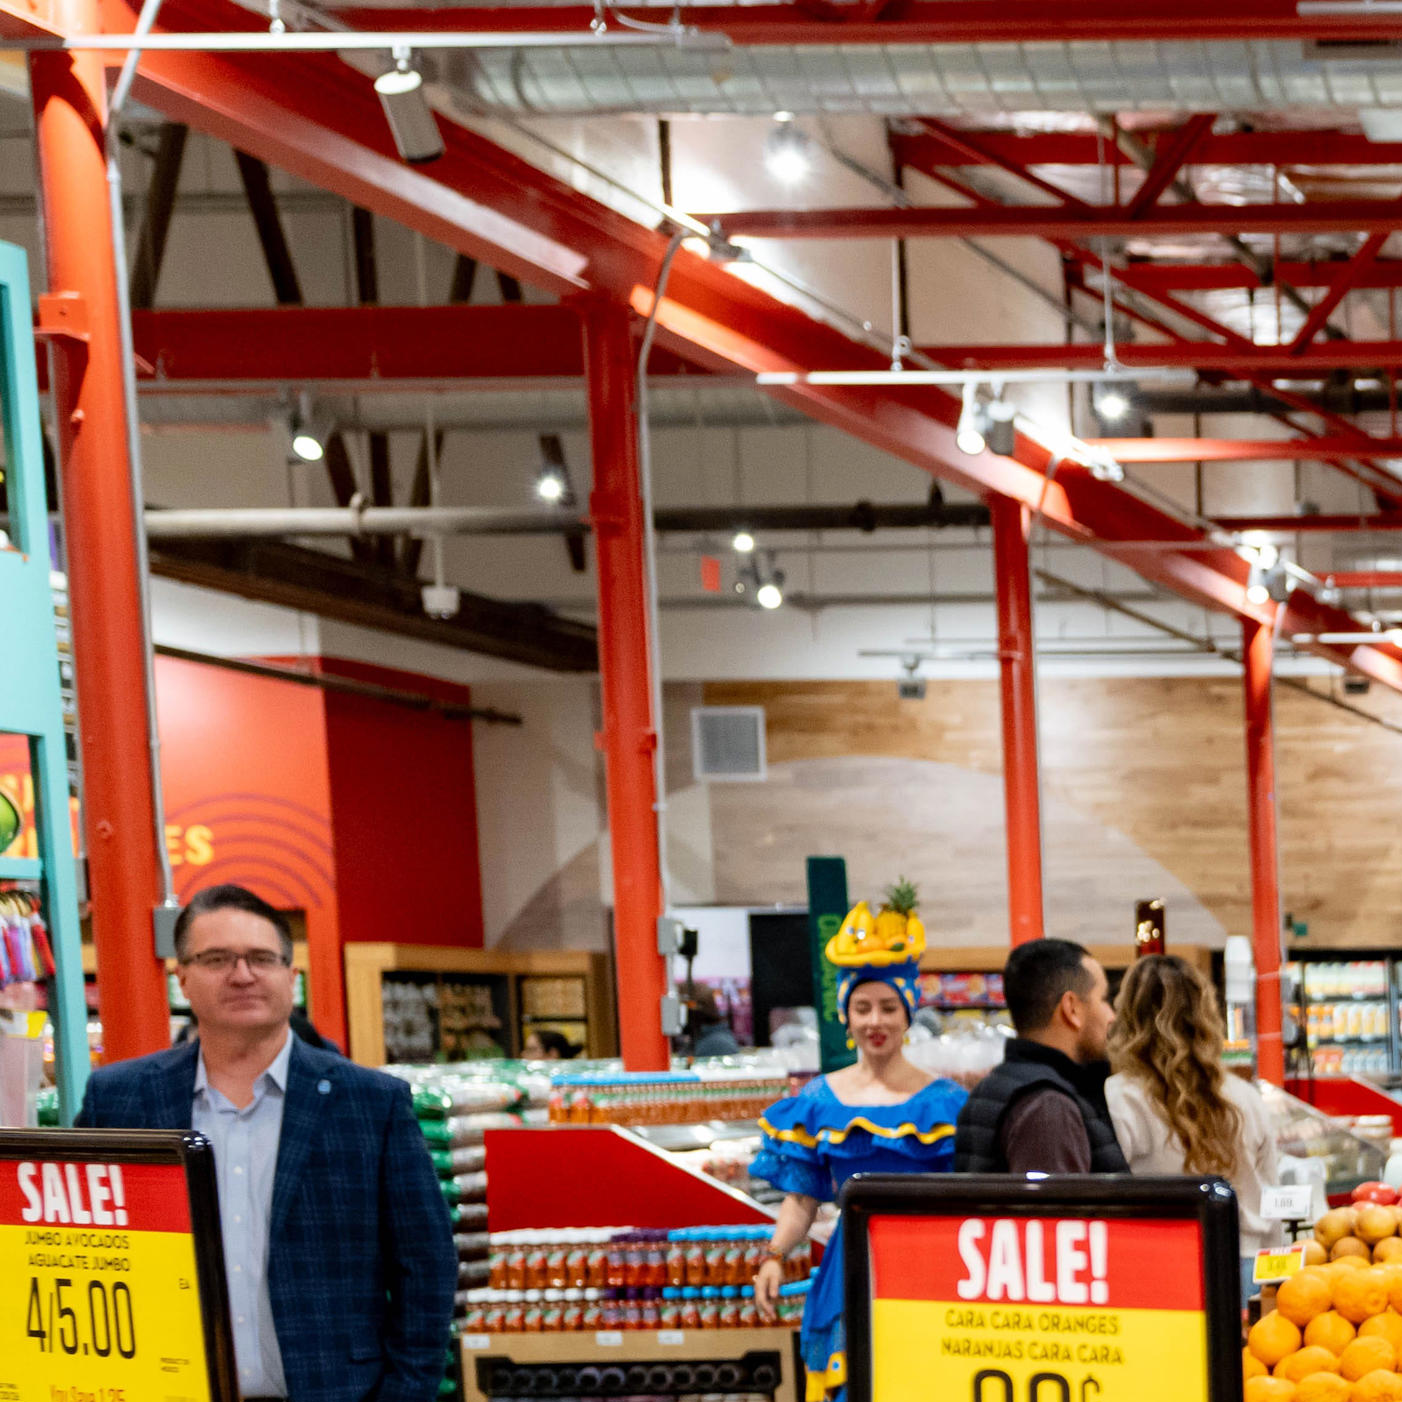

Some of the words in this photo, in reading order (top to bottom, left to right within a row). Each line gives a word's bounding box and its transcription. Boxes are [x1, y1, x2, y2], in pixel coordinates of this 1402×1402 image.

[165, 824, 214, 867] ES
[17, 1161, 128, 1226] SALE!
[25, 1231, 61, 1246] JUMBO
[65, 1233, 130, 1249] AVOCADOS
[28, 1253, 89, 1270] AGUACATE
[91, 1256, 131, 1272] JUMBO
[957, 1218, 1110, 1304] SALE!
[27, 1277, 136, 1359] 4/5.00
[945, 1309, 986, 1329] CARA
[990, 1311, 1034, 1331] CARA
[1038, 1314, 1119, 1335] ORANGES
[941, 1337, 1024, 1361] NARANJAS
[1027, 1342, 1073, 1362] CARA
[1077, 1344, 1124, 1365] CARA
